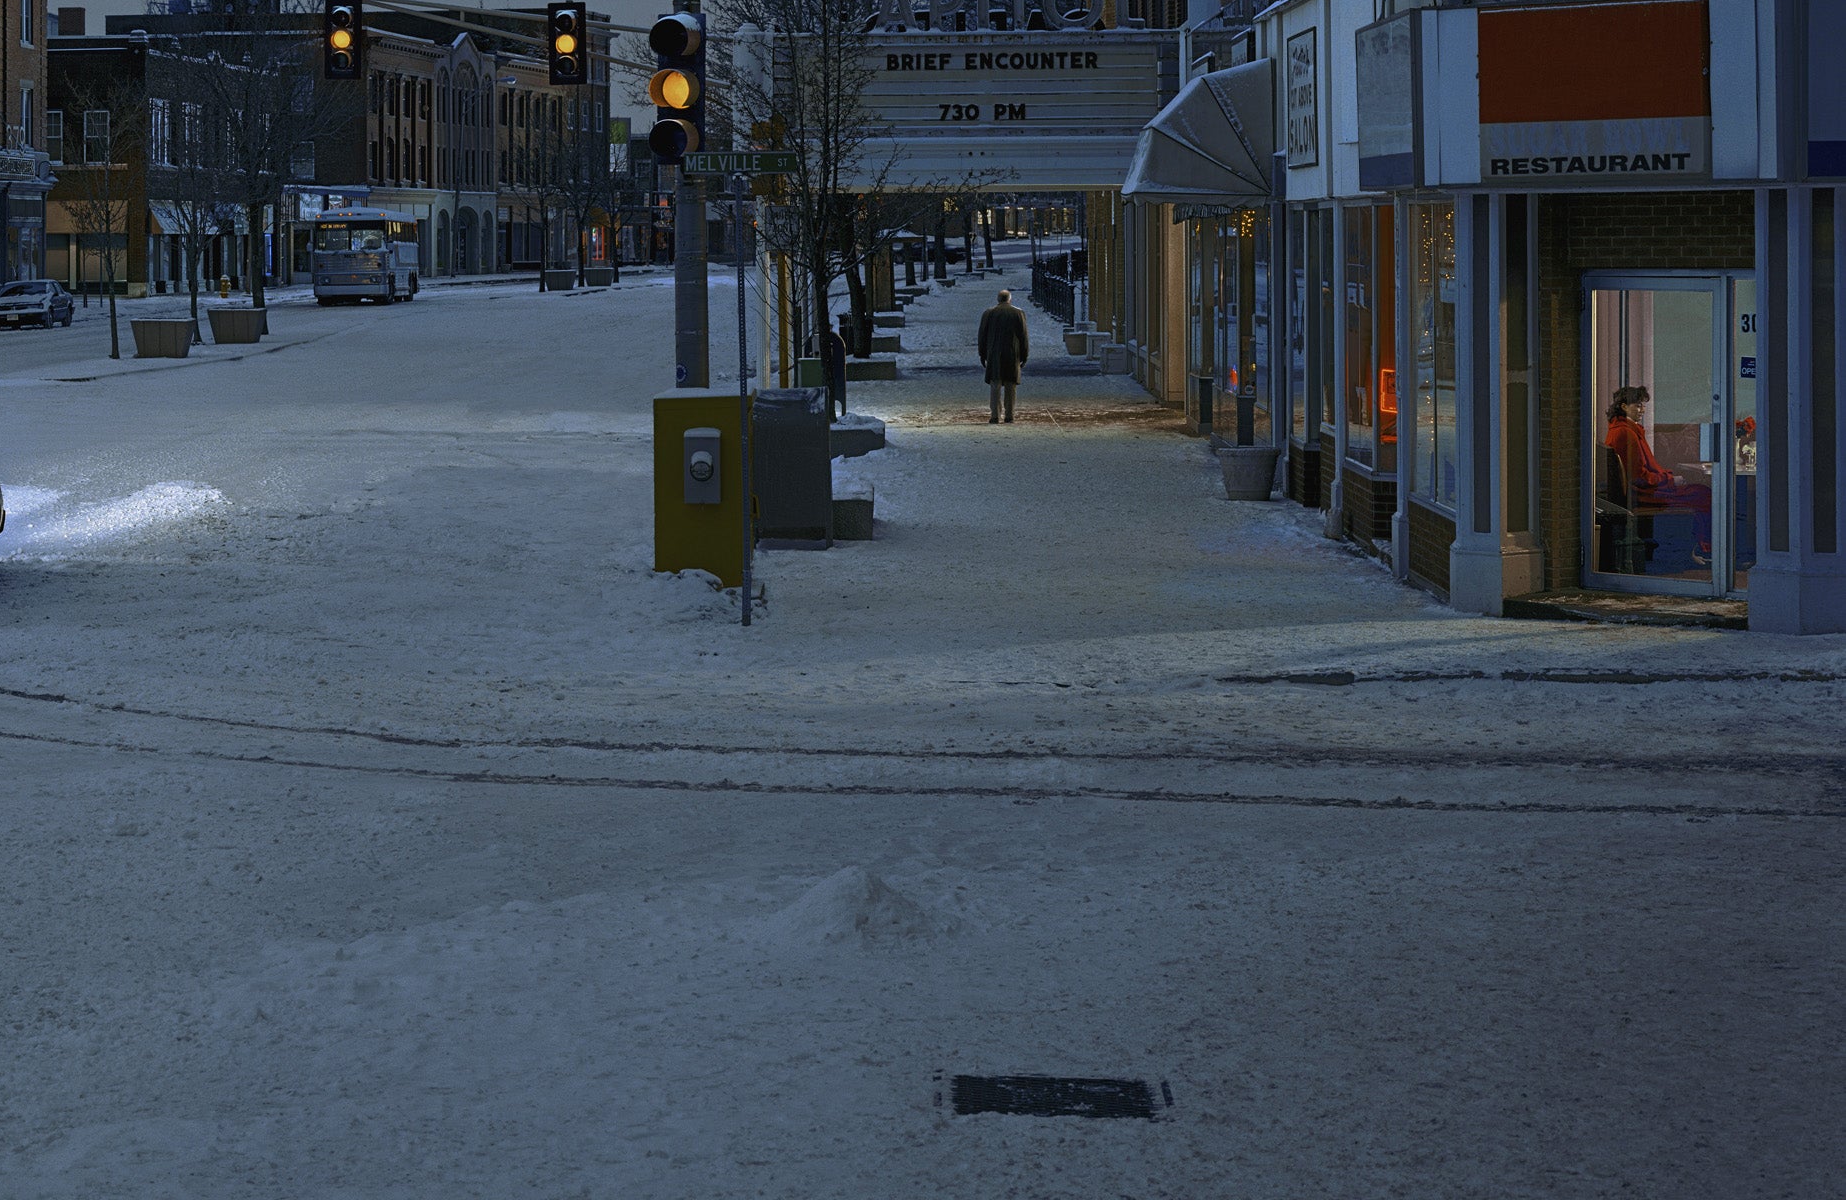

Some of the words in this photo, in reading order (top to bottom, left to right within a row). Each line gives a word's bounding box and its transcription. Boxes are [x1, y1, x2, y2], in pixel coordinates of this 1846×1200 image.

[886, 53, 952, 71] BRIEF
[965, 52, 1099, 70] ENCOUNTER
[938, 103, 980, 121] 730
[994, 103, 1026, 121] PM
[1290, 115, 1315, 154] SALON
[1490, 123, 1588, 157] SUGAR
[1602, 118, 1691, 153] BOWL
[685, 155, 762, 172] MELVILLE
[777, 158, 788, 167] ST
[1490, 152, 1691, 176] RESTAURANT
